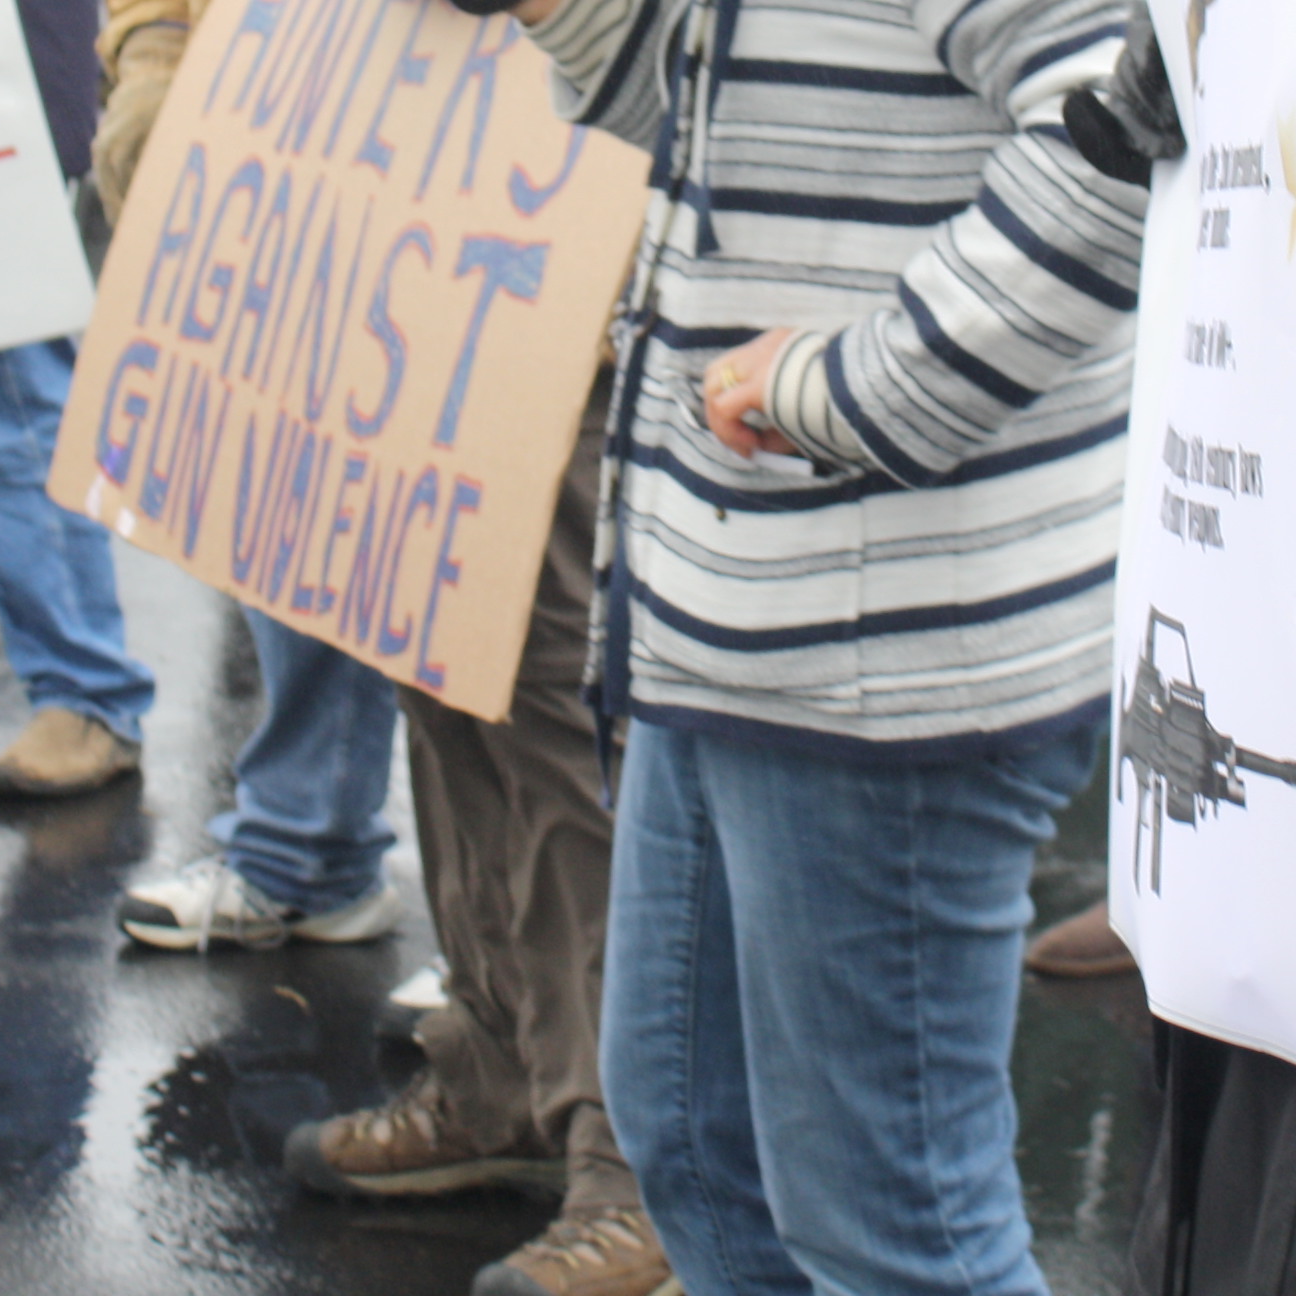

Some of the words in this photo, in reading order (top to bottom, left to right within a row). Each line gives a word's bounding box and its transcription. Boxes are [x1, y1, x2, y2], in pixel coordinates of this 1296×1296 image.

[137, 141, 551, 451] AGAINST
[95, 337, 233, 560] GUN
[231, 408, 484, 692] VIOLENCE
